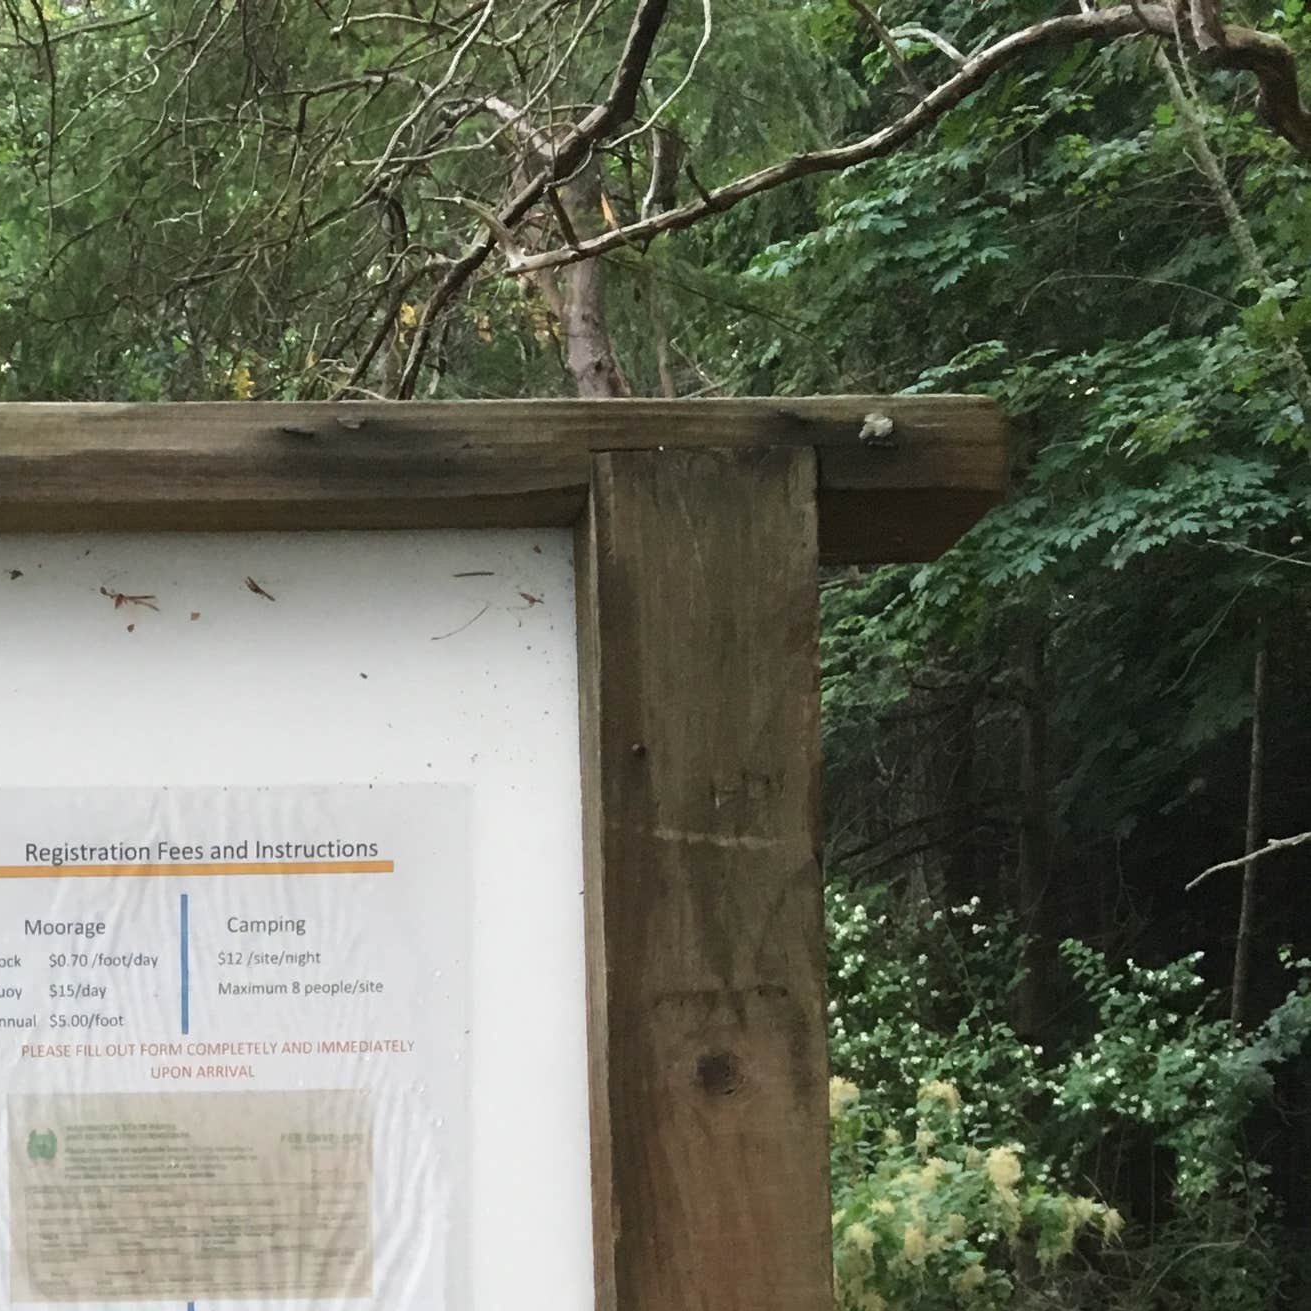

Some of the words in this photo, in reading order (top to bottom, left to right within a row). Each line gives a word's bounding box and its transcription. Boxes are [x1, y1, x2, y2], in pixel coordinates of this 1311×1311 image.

[24, 842, 151, 866] Registration
[157, 842, 204, 861] Fees
[210, 841, 248, 860] and
[255, 840, 379, 859] Instructions
[24, 919, 106, 939] Moorage
[227, 916, 306, 936] Camping
[48, 952, 88, 969] $0.70
[91, 952, 159, 970] /foot/day
[217, 951, 244, 967] $12
[246, 950, 321, 967] /site/night
[48, 983, 107, 1000] $15/day
[218, 981, 288, 996] Maximum
[292, 981, 301, 994] 8
[304, 979, 384, 997] people/site
[48, 1013, 124, 1029] $5.00/foot
[21, 1044, 72, 1058] PLEASE
[75, 1043, 103, 1057] FILL
[105, 1043, 136, 1057] OUT
[140, 1043, 183, 1057] FORM
[186, 1042, 278, 1057] COMPLETELY
[281, 1041, 313, 1055] AND
[317, 1040, 415, 1055] IMMEDIATELY
[150, 1065, 193, 1079] UPON
[195, 1065, 255, 1078] ARRIVAL
